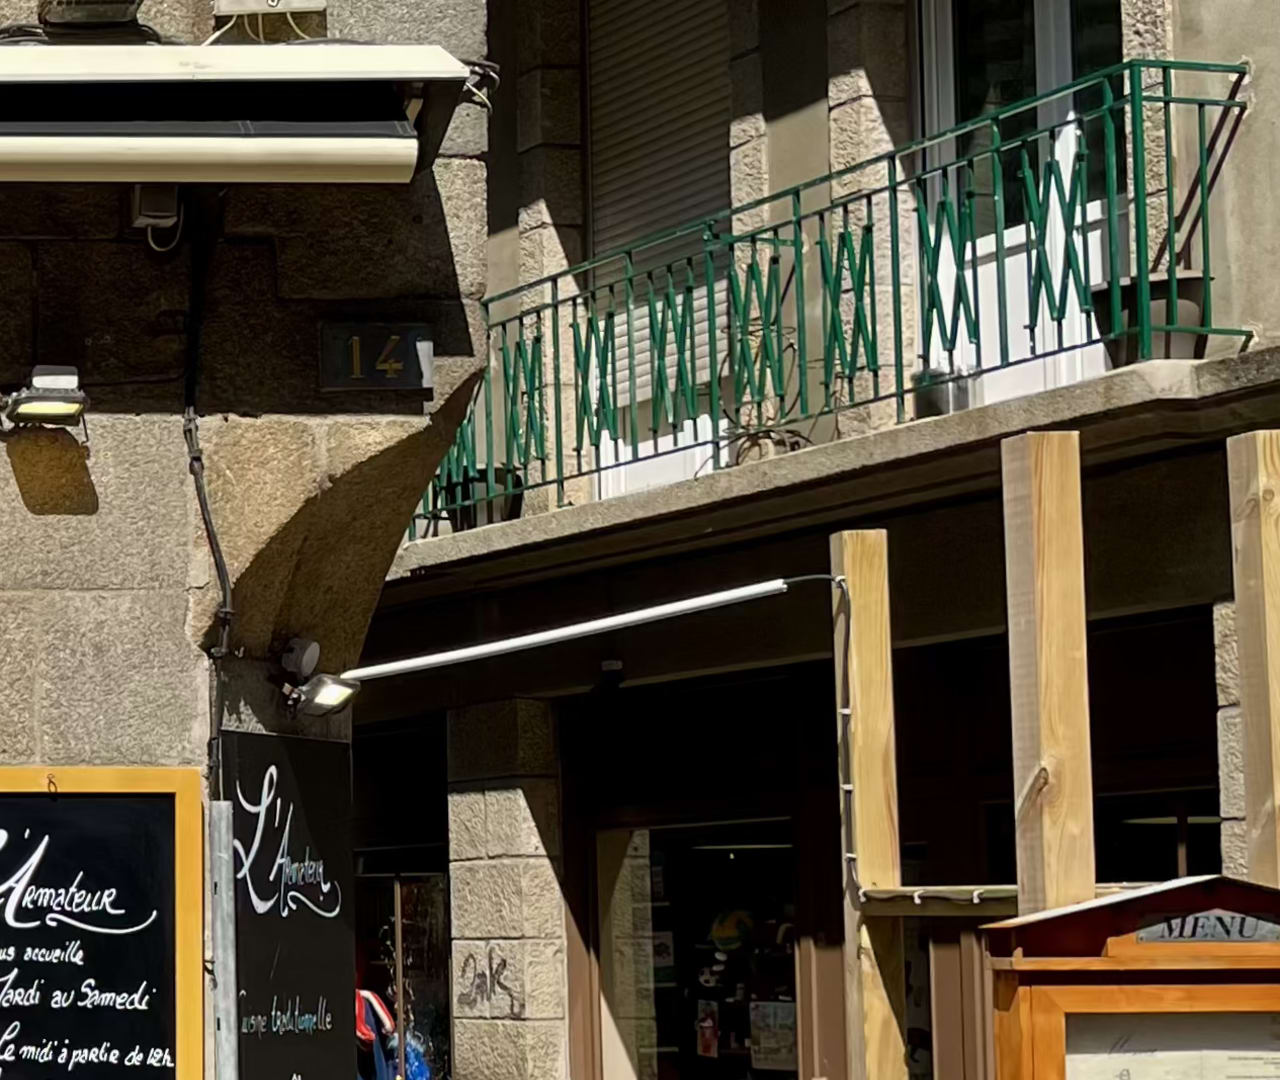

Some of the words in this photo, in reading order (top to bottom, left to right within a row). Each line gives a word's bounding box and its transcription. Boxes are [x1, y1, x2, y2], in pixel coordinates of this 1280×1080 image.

[348, 336, 404, 378] 14
[1159, 915, 1261, 940] MENU
[24, 941, 84, 965] accueille
[51, 990, 72, 1008] au
[77, 978, 156, 1010] Samedi
[19, 1039, 57, 1063] midi
[124, 1045, 143, 1066] de
[146, 1047, 174, 1068] 12h
